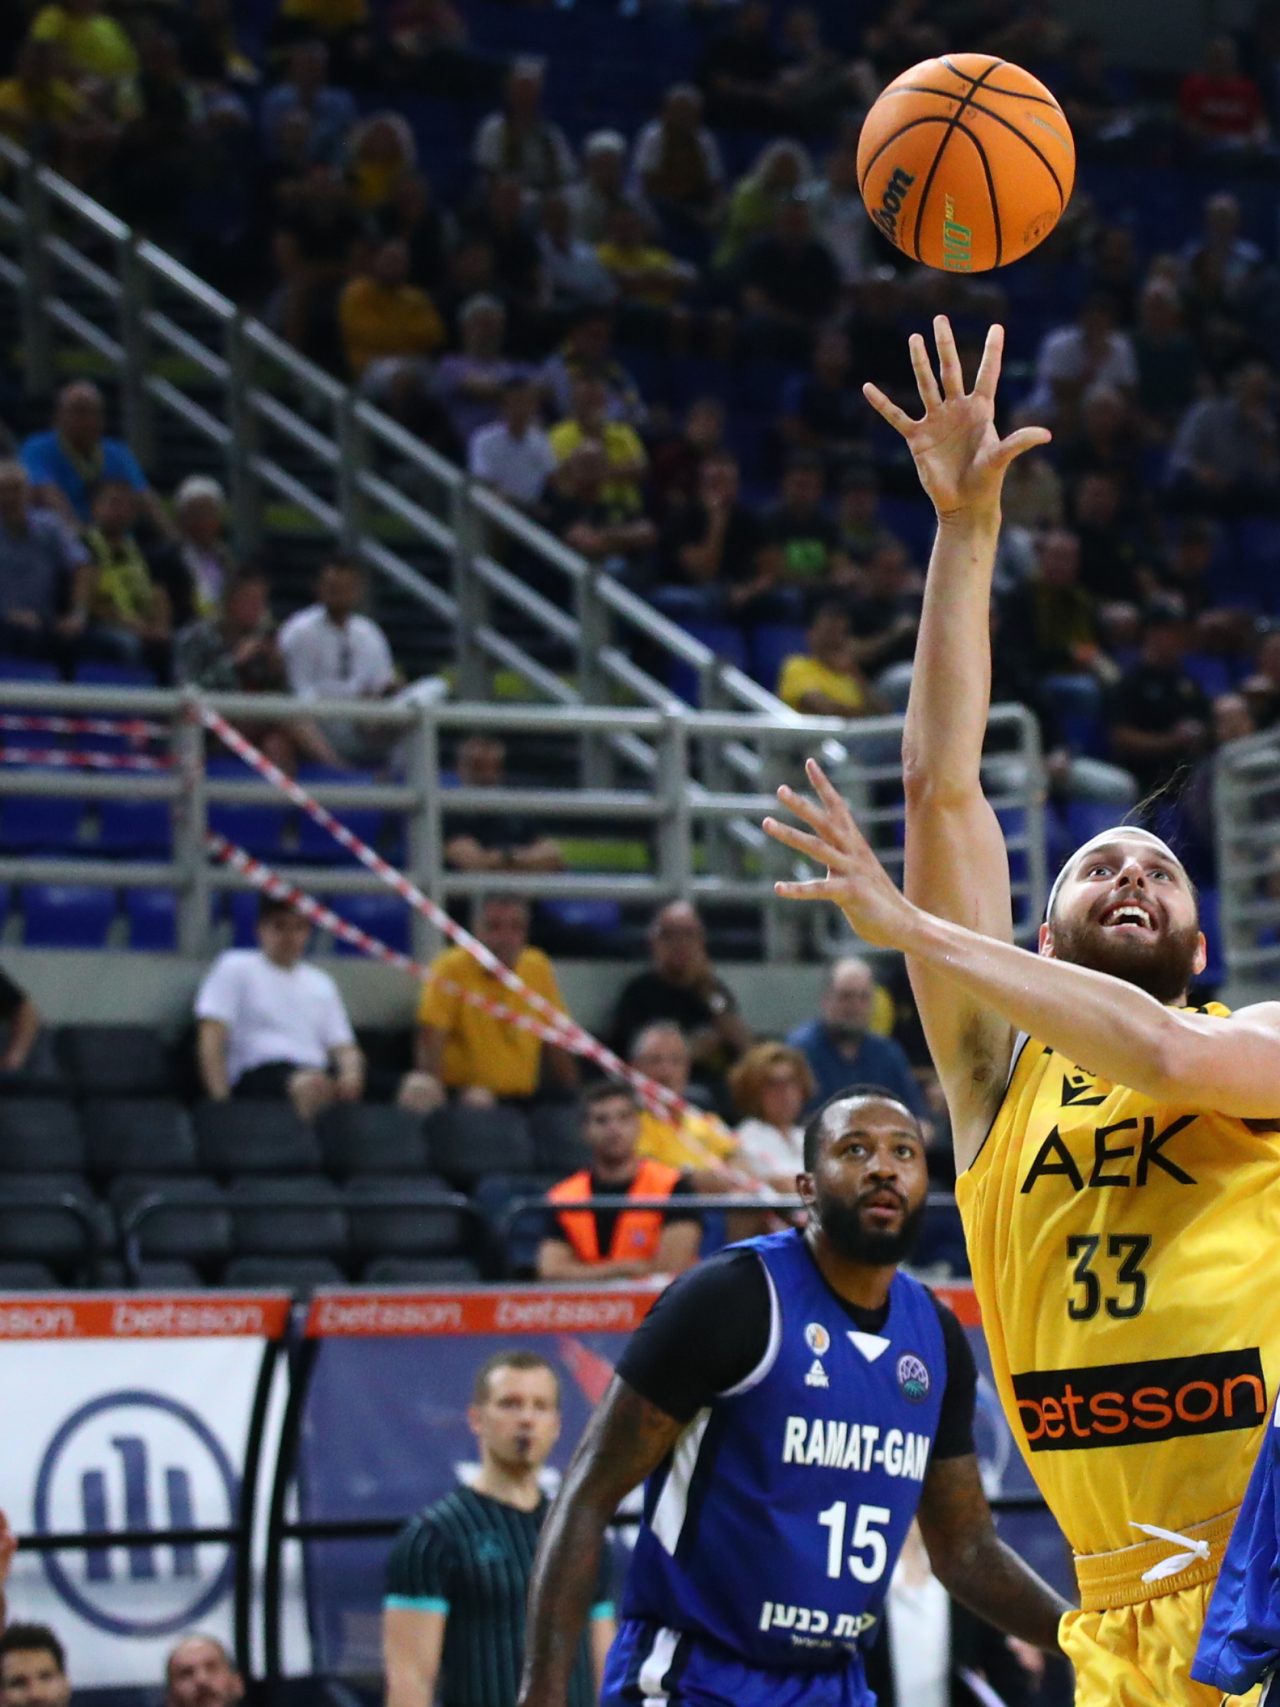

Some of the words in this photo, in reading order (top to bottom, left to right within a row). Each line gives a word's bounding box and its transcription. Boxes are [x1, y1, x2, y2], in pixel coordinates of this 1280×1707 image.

[1021, 1115, 1199, 1194] AEK
[1066, 1233, 1152, 1322] 33
[783, 1416, 931, 1482] RAMAT-GAN
[818, 1501, 890, 1584] 15
[759, 1601, 829, 1633] כנען
